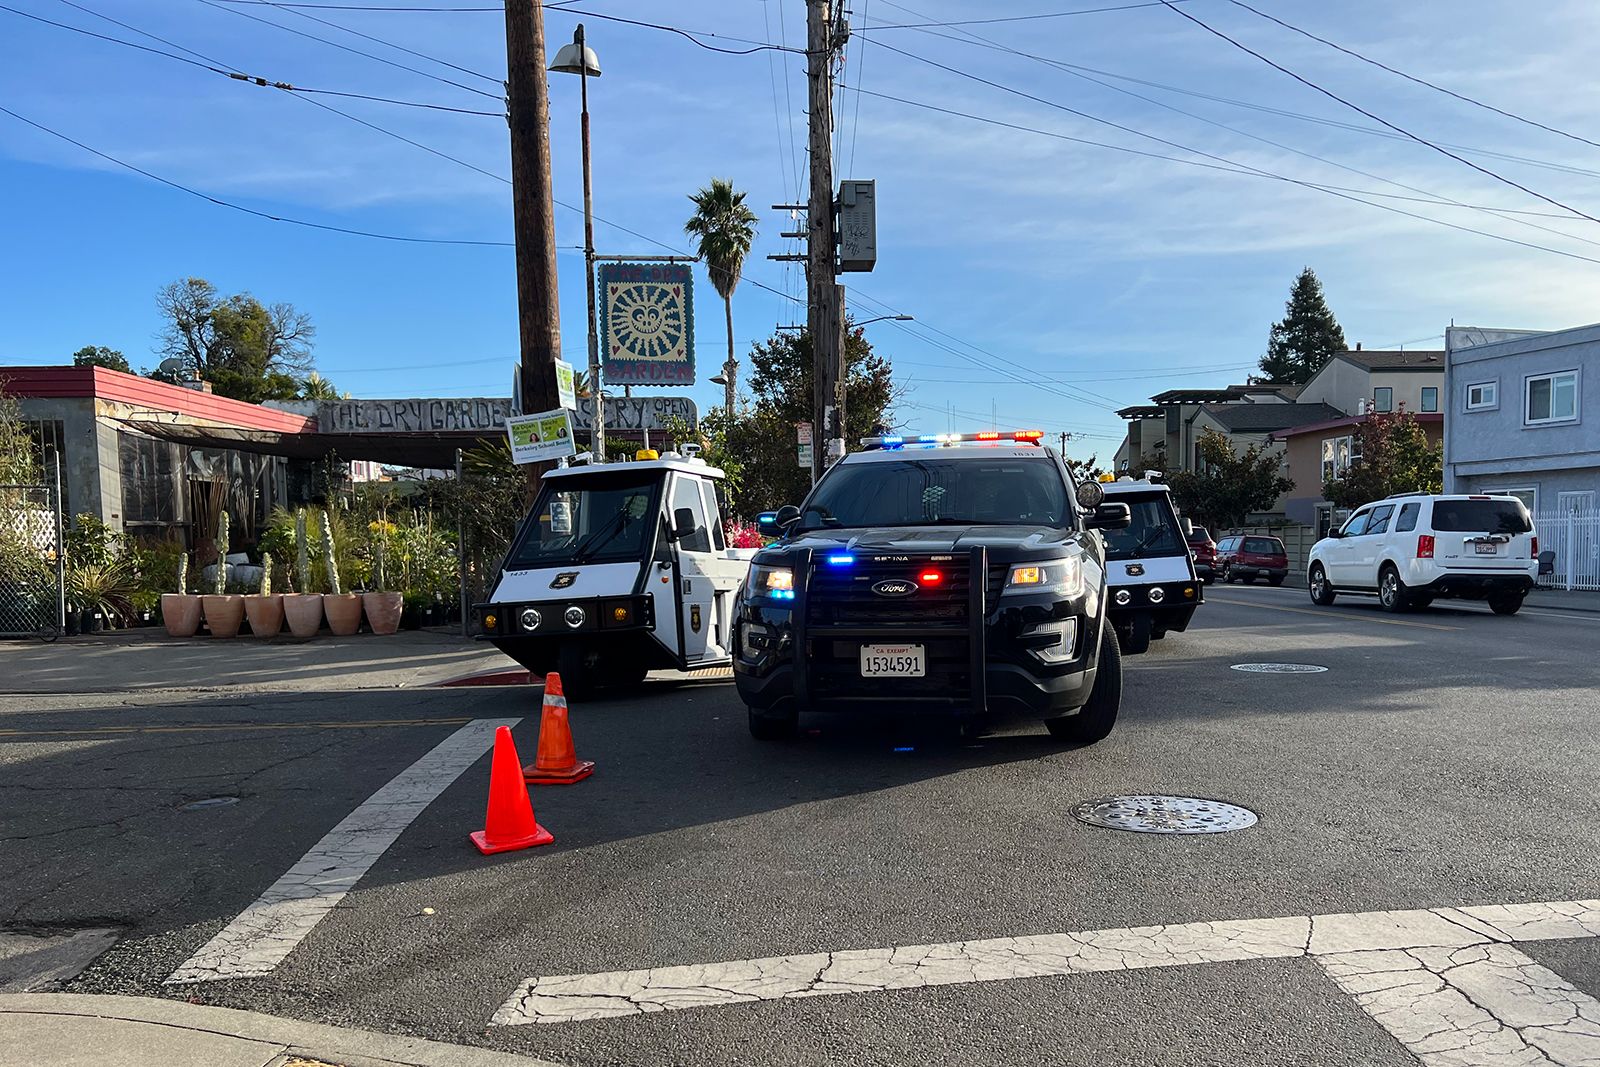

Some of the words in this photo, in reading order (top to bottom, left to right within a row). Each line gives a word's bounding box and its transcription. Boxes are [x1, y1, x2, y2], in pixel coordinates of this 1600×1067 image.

[606, 363, 691, 380] GARDEN
[654, 399, 689, 414] OPEN
[327, 402, 369, 430] THE
[374, 402, 424, 431] DRY
[515, 445, 538, 453] Berkeley
[538, 441, 555, 449] School
[556, 439, 570, 447] Board
[880, 583, 907, 593] Ford
[865, 656, 921, 672] 1534591
